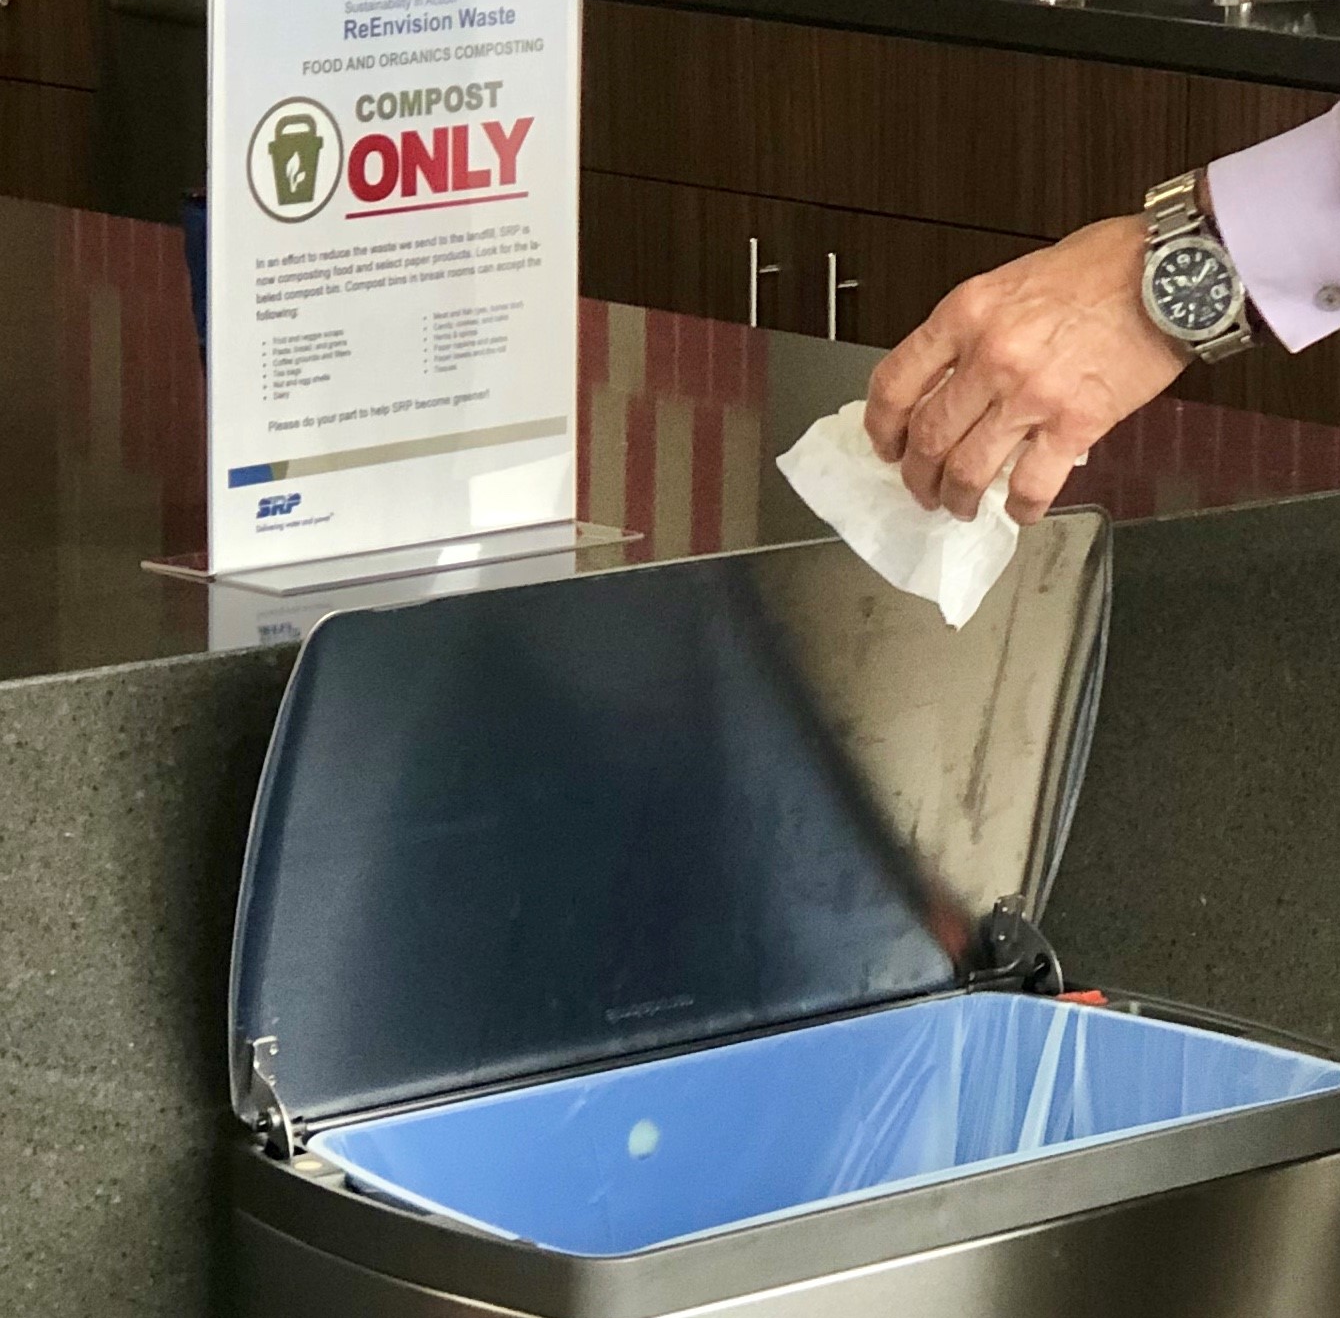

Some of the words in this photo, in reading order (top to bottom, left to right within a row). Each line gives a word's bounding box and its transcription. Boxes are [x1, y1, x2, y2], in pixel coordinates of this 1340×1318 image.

[344, 14, 453, 40] ReEnvision
[458, 6, 516, 29] Waste
[302, 57, 343, 75] FOOD
[346, 54, 375, 71] AND
[379, 46, 451, 68] ORGANICS
[454, 38, 544, 61] COMPOSTING
[355, 80, 503, 123] COMPOST
[347, 117, 535, 203] ONLY
[319, 249, 351, 261] reduce
[353, 246, 367, 257] the
[415, 237, 437, 249] send
[438, 235, 447, 245] to
[449, 233, 464, 243] the
[499, 224, 520, 237] SRP
[256, 276, 275, 285] now
[277, 269, 331, 283] composting
[333, 265, 353, 276] food
[355, 262, 373, 273] and
[375, 259, 402, 270] select
[404, 255, 430, 268] paper
[476, 246, 497, 257] Look
[514, 241, 528, 252] the
[284, 286, 323, 300] compost
[344, 277, 386, 292] Compost
[420, 271, 445, 282] break
[447, 267, 475, 278] rooms
[477, 263, 494, 274] can
[496, 259, 525, 272] accept
[527, 257, 541, 268] the
[268, 417, 300, 432] Please
[302, 416, 315, 427] do
[317, 413, 337, 427] your
[339, 409, 358, 423] part
[359, 408, 369, 418] to
[370, 403, 391, 417] help
[392, 399, 413, 413] SRP
[415, 395, 451, 410] become
[256, 492, 303, 519] SRP
